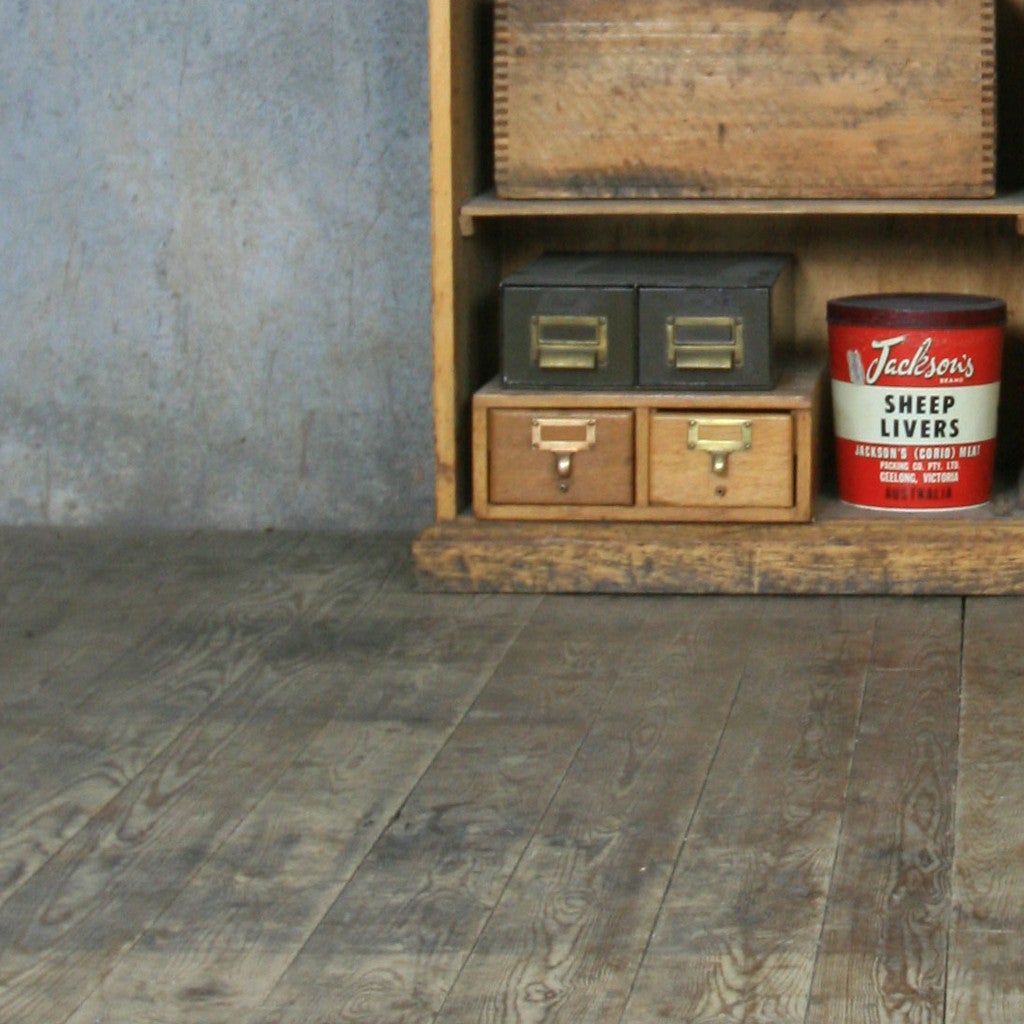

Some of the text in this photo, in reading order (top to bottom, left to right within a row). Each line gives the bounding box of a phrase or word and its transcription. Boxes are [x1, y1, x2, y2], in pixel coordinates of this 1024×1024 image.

[865, 334, 975, 385] Jackson's
[884, 394, 956, 414] SHEEP
[880, 418, 960, 438] LIVERS
[855, 444, 981, 460] JACKSON'S (CORIO) MEAT
[879, 460, 910, 471] PACKING
[922, 472, 960, 484] VICTORIA
[885, 486, 952, 500] AUSTRALIA
